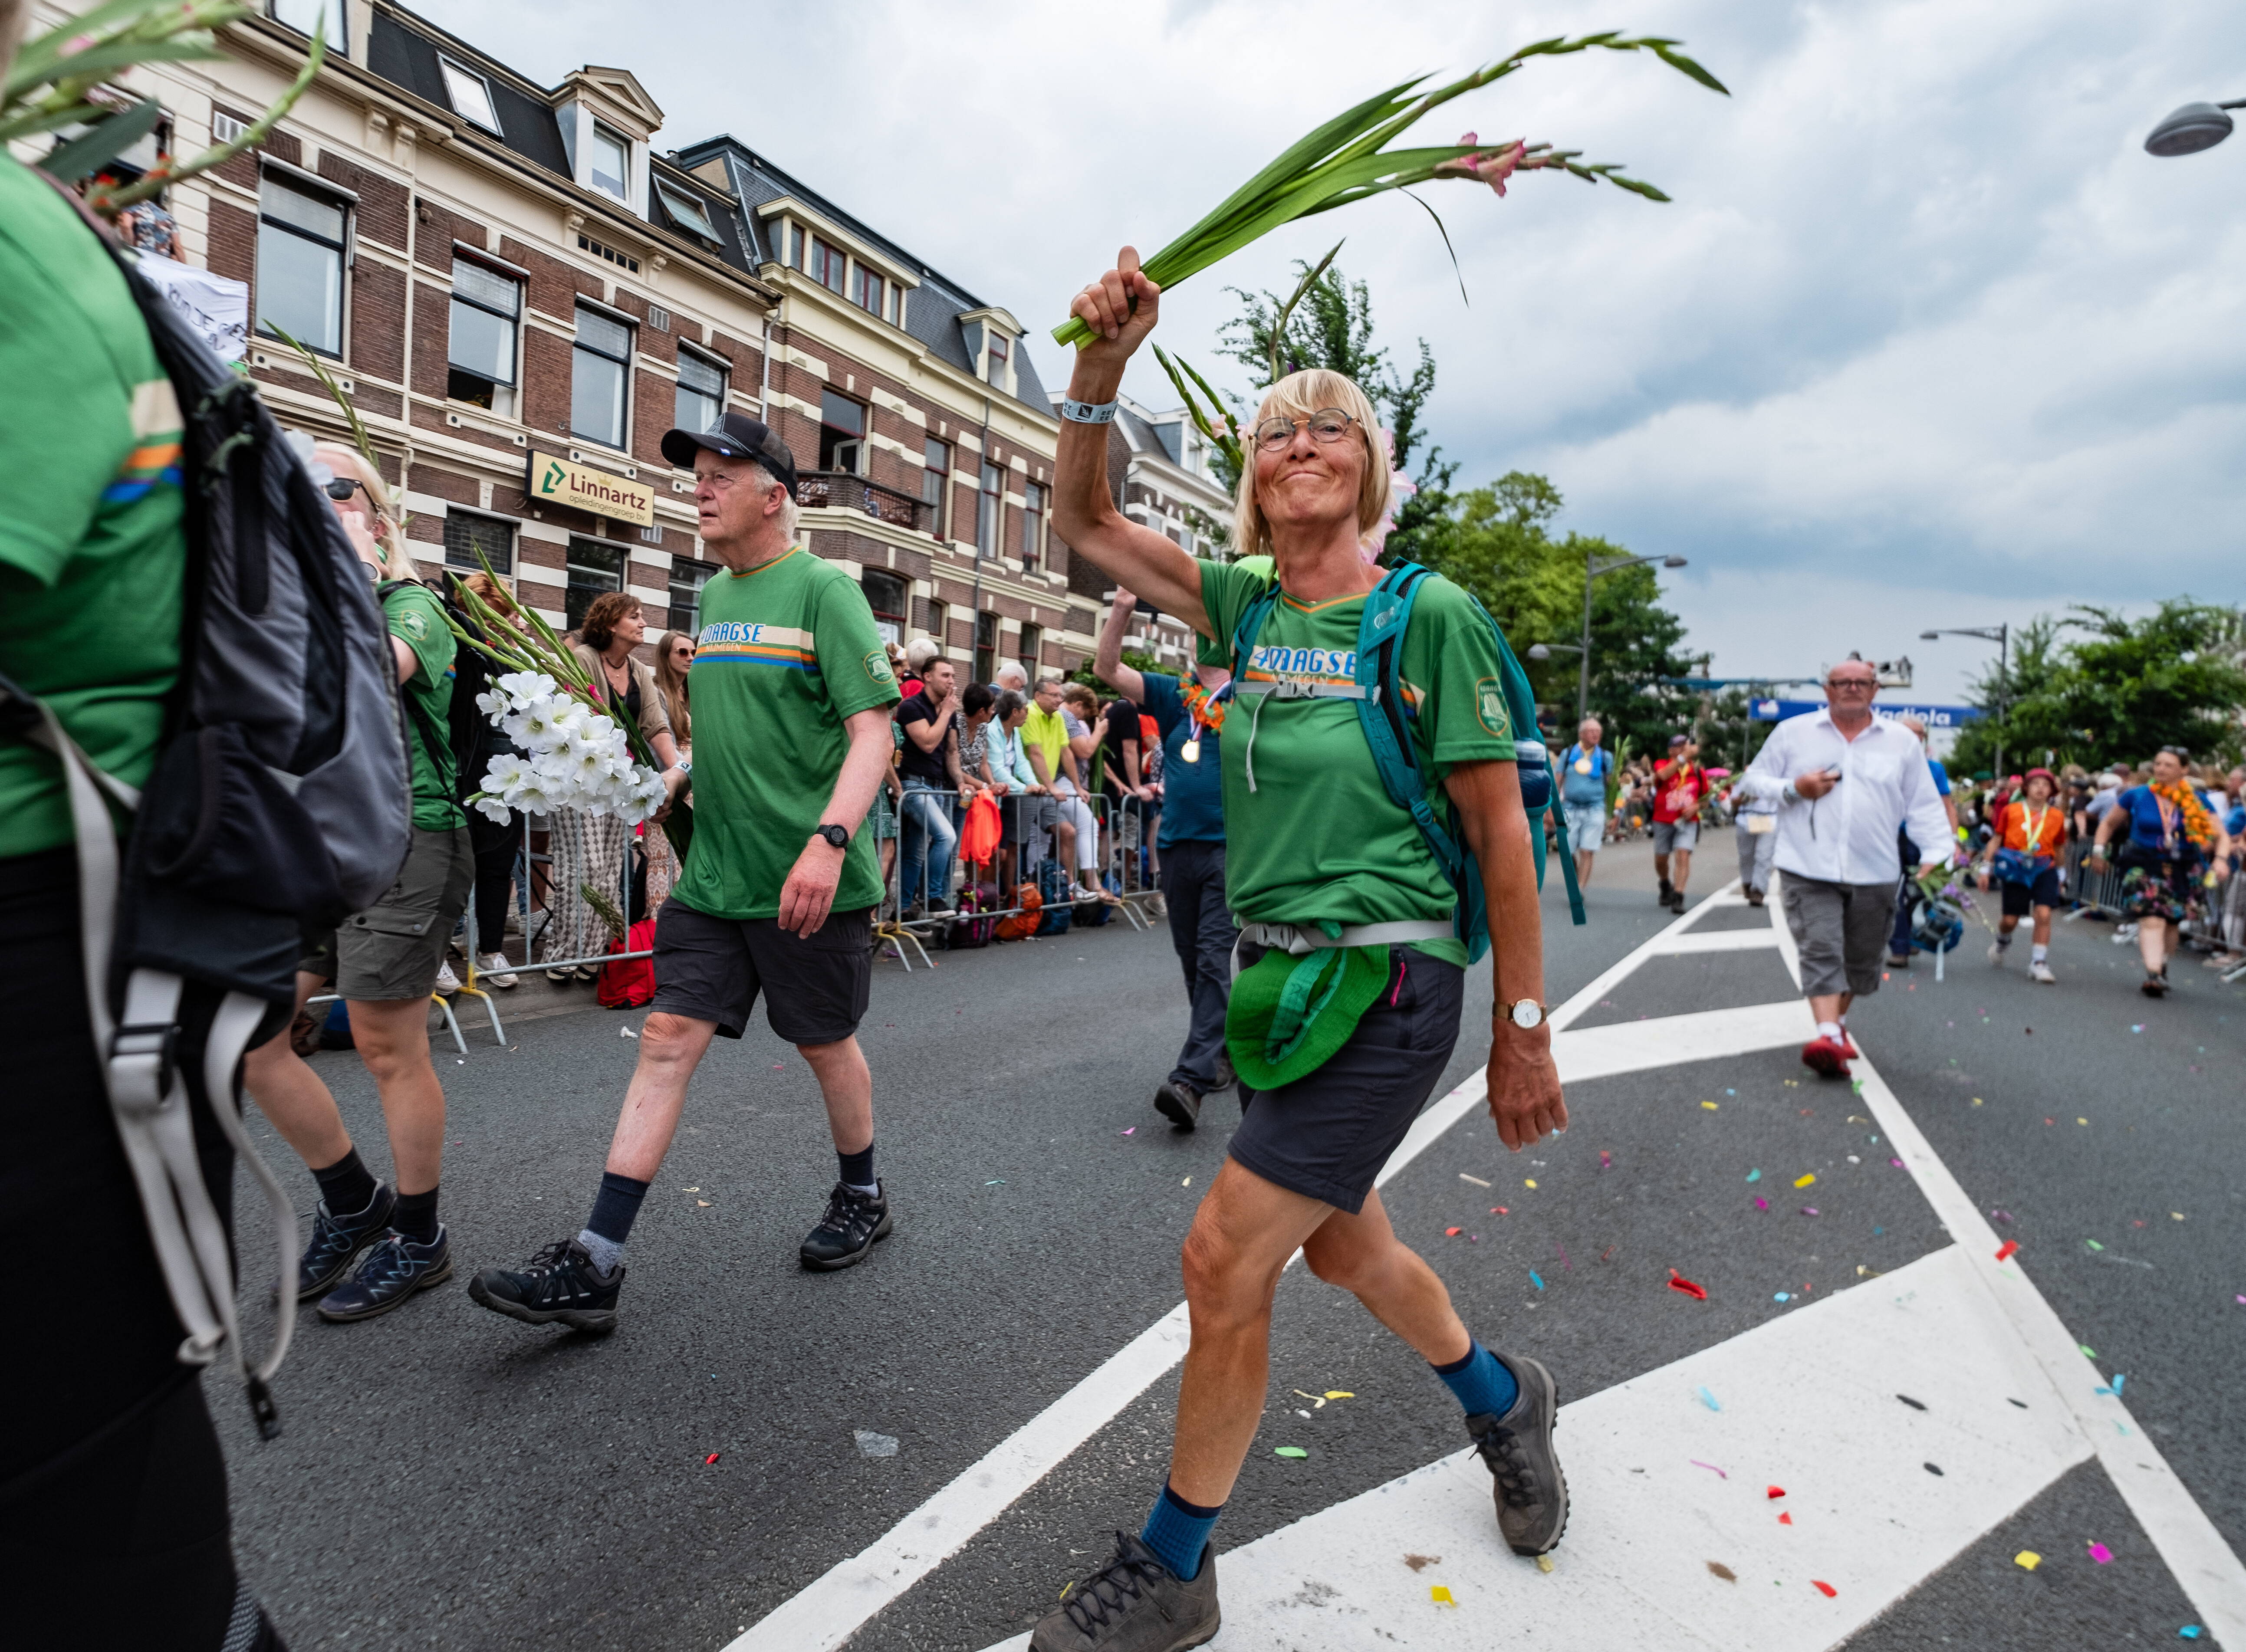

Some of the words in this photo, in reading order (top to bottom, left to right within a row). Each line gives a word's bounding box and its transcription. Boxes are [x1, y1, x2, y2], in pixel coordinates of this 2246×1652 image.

[571, 473, 645, 510] Linnartz
[569, 496, 635, 518] opleidingengroep
[636, 512, 645, 521] bv
[705, 643, 741, 652] NIJMEGEN
